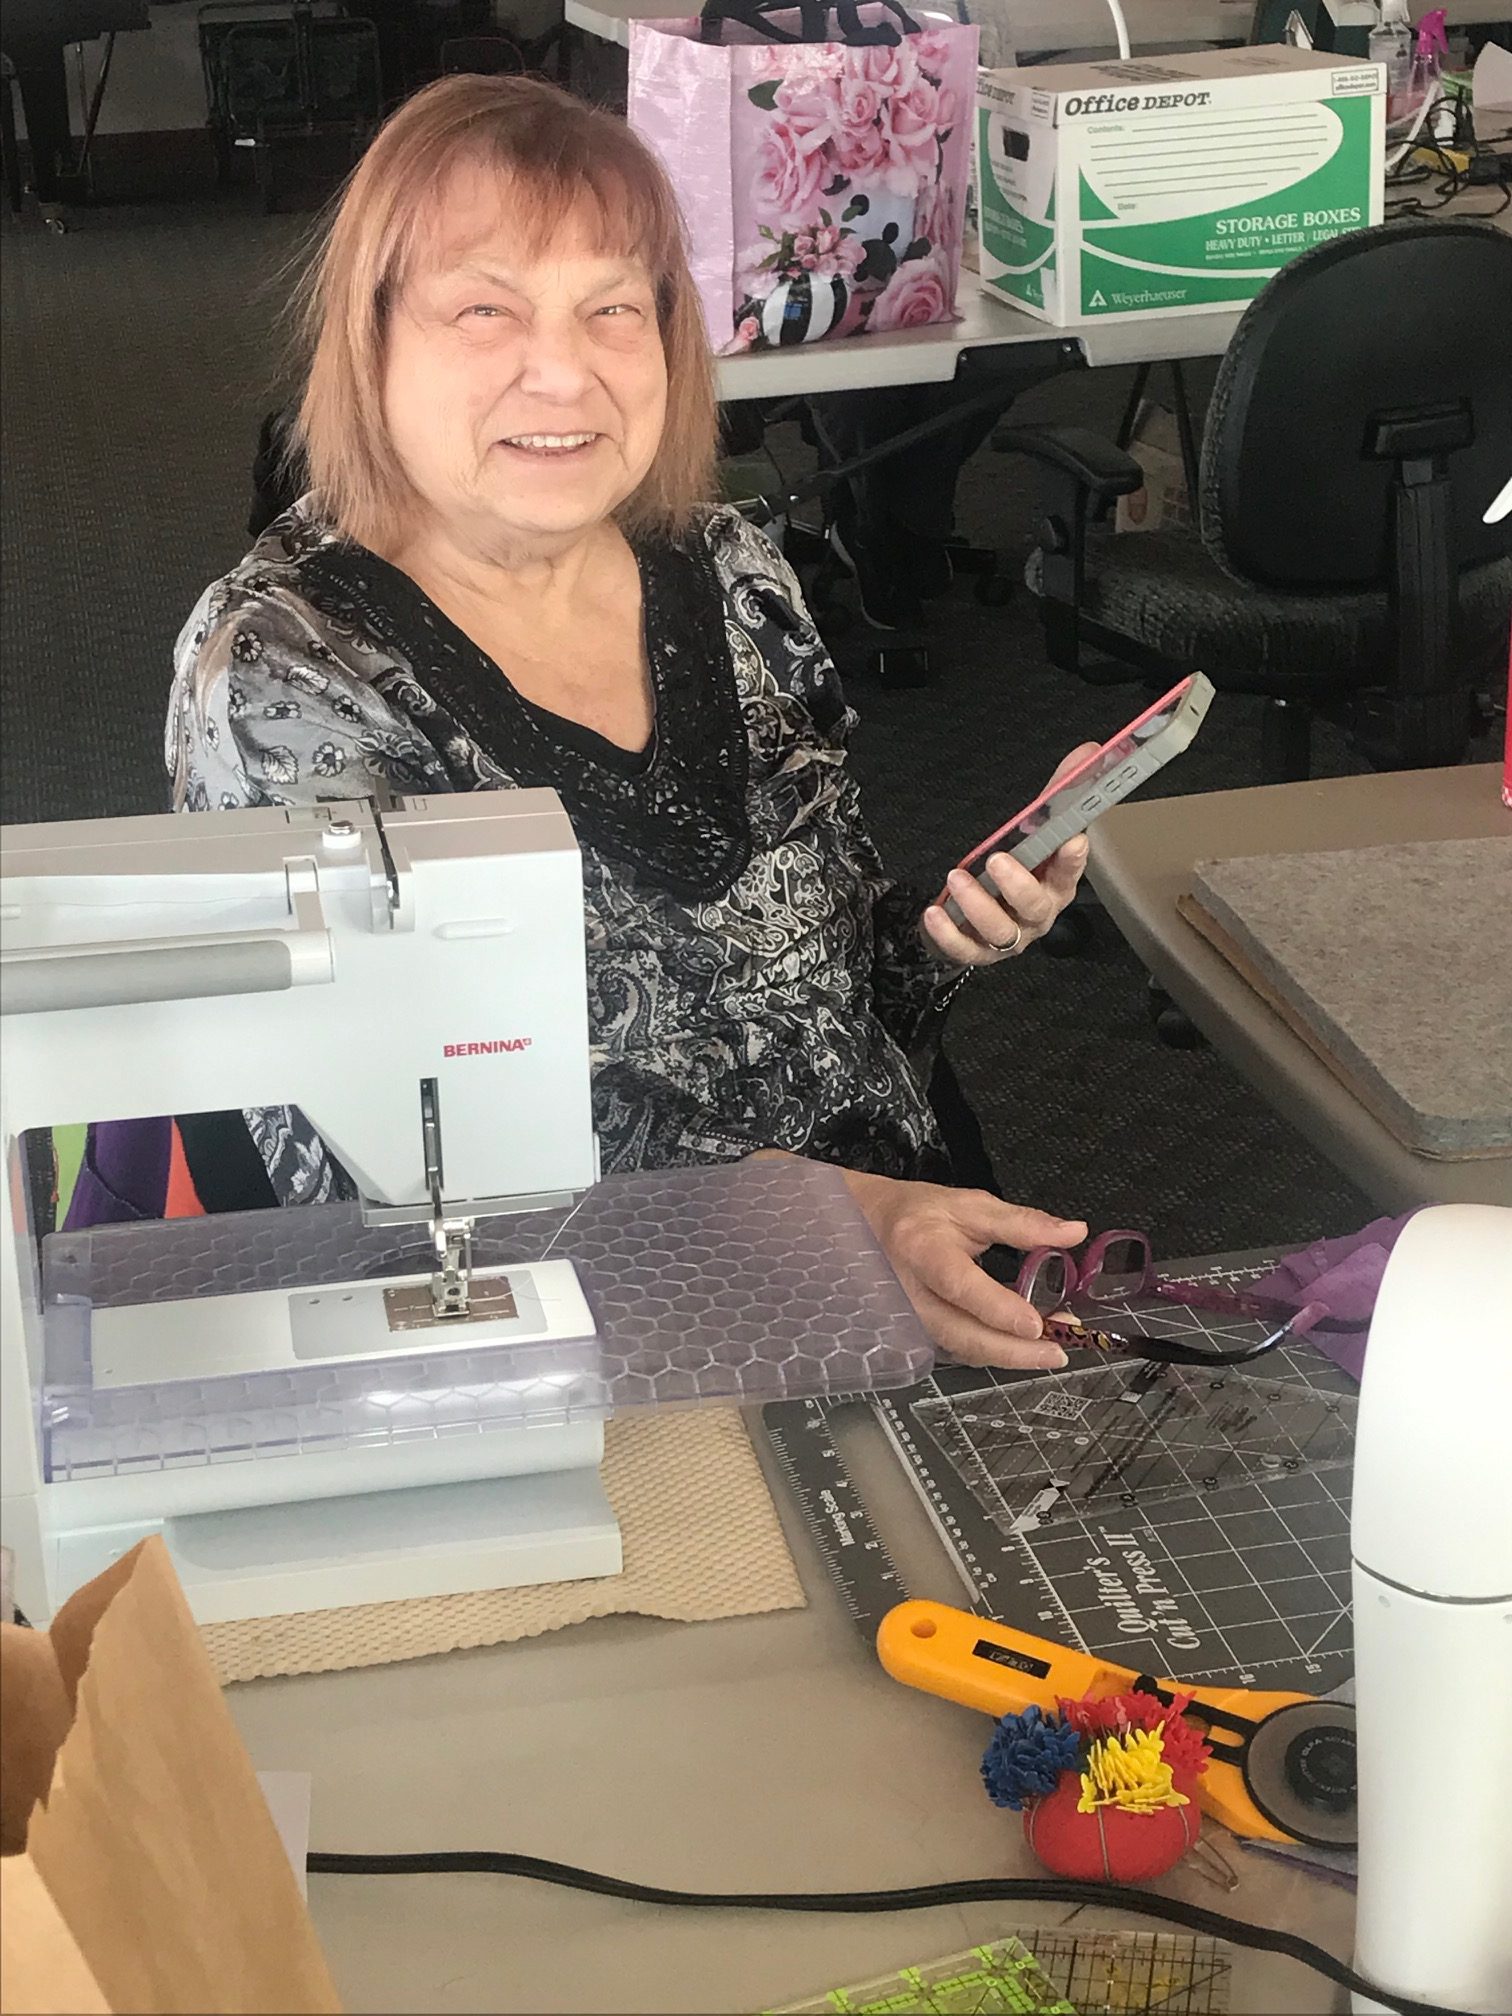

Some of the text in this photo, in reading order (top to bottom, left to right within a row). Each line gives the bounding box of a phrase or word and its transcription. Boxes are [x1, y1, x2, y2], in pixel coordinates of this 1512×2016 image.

[1065, 94, 1140, 116] Office
[1216, 207, 1361, 235] STORAGE BOXES
[1206, 239, 1236, 251] HEAVY
[1237, 236, 1261, 249] DUTY
[1272, 231, 1305, 245] LETTER
[443, 1039, 525, 1057] BERNINA
[1122, 1550, 1169, 1594] Press
[1083, 1557, 1159, 1633] Quilter's
